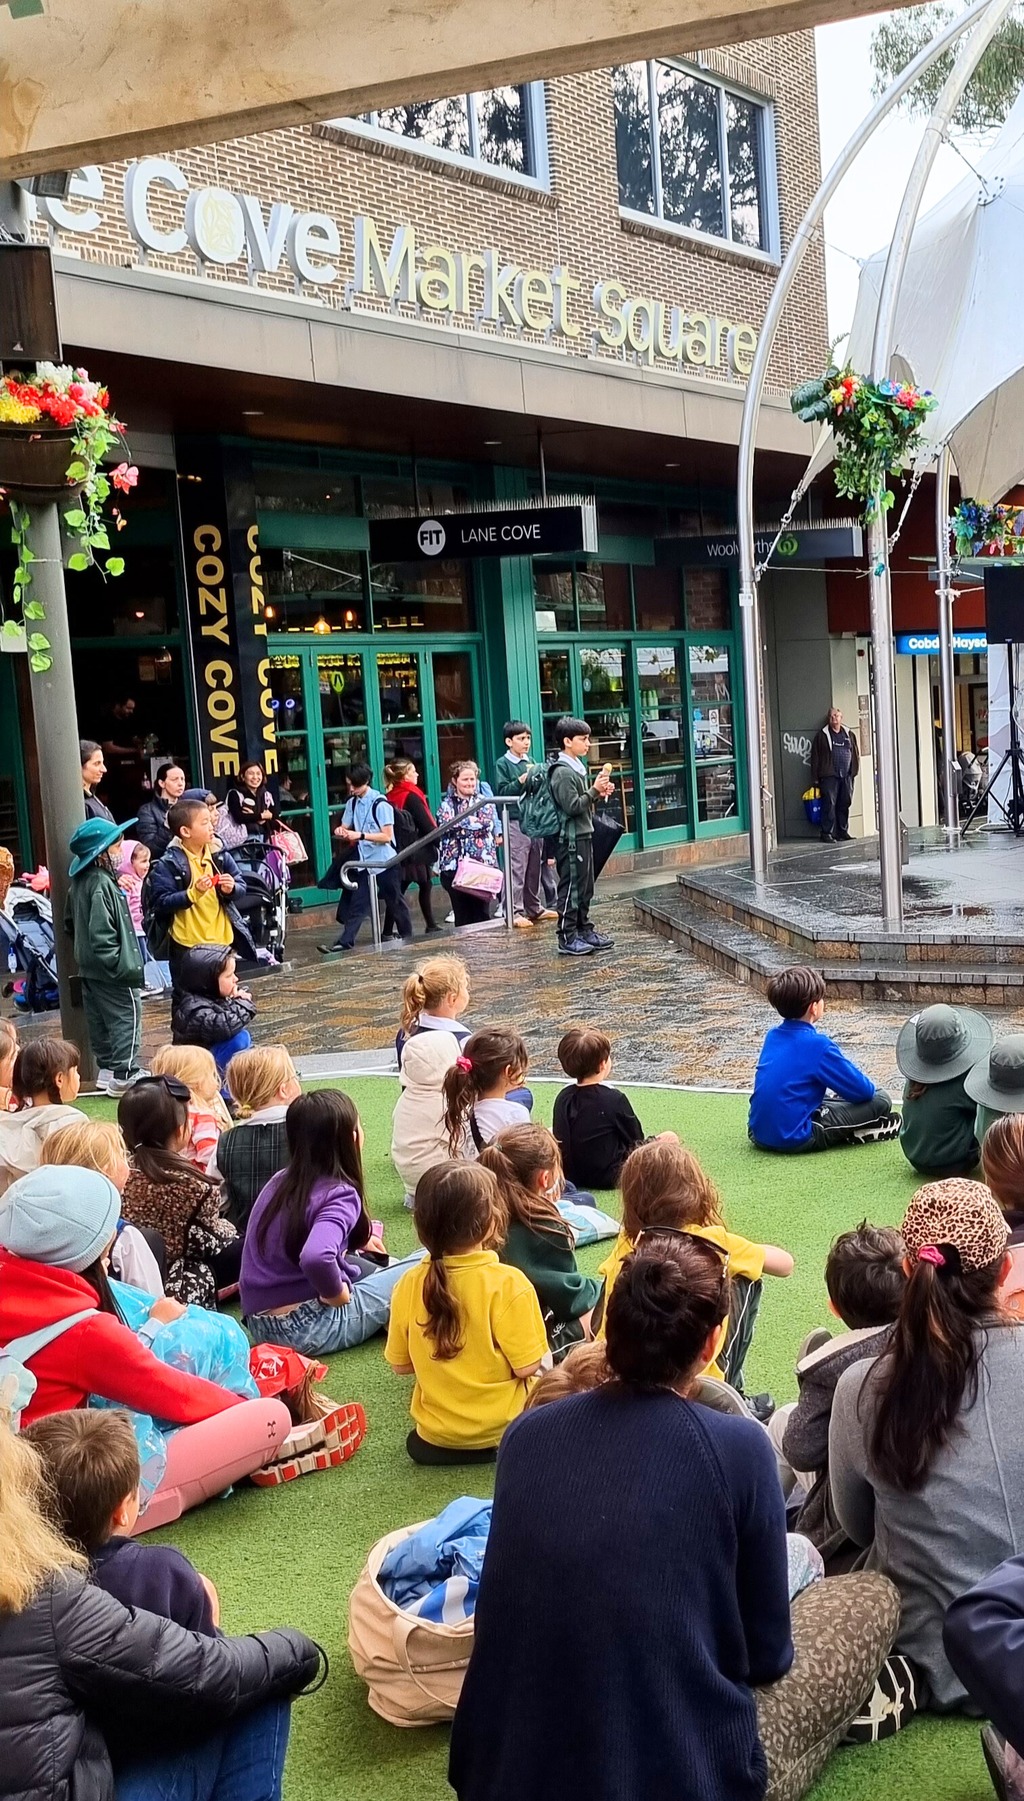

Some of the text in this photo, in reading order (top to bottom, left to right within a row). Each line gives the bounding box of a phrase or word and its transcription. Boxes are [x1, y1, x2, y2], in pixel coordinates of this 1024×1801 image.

[124, 158, 342, 284] Cove
[354, 214, 581, 337] Market
[592, 280, 757, 376] Square
[419, 524, 541, 546] FIT LANE COVE
[193, 524, 241, 777] COZY COVE
